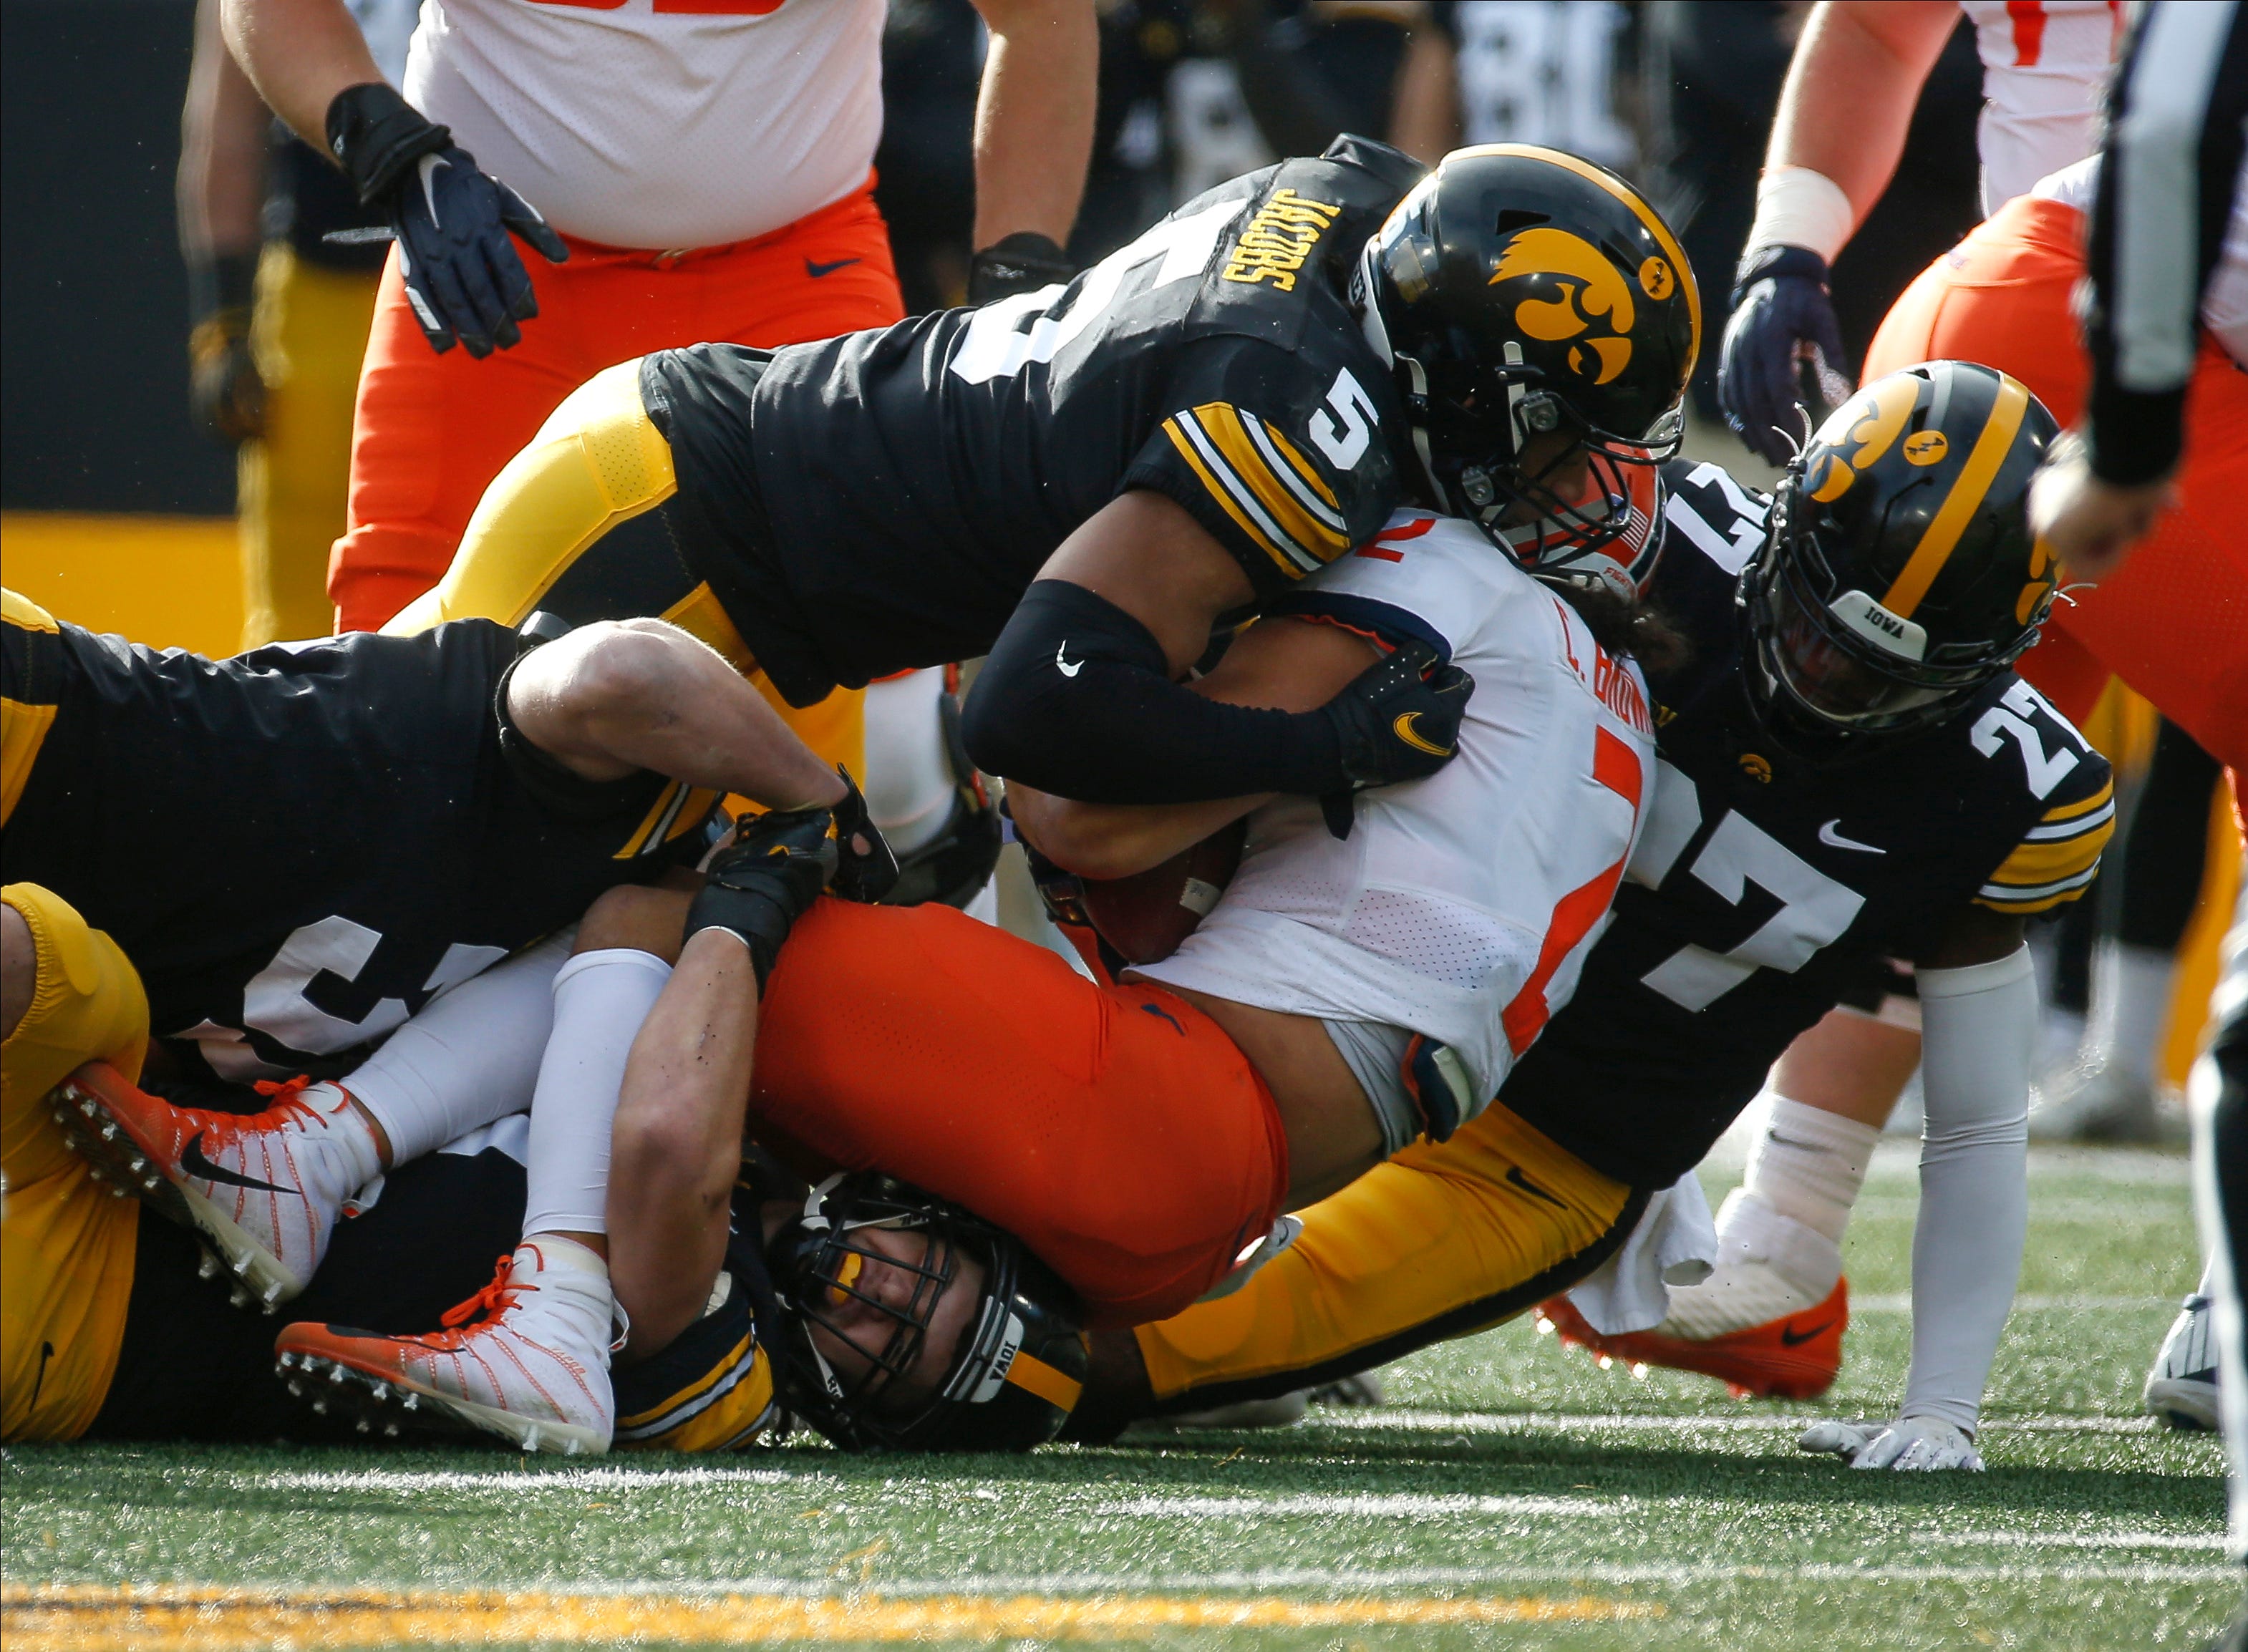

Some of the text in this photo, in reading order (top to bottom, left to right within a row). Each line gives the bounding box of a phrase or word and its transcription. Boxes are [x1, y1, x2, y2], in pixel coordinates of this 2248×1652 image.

[1222, 189, 1341, 291] JACOBS
[1308, 367, 1379, 470] 5
[1864, 606, 1904, 639] IOWA
[1970, 678, 2093, 801] 27
[989, 1340, 1017, 1381] IOWA
